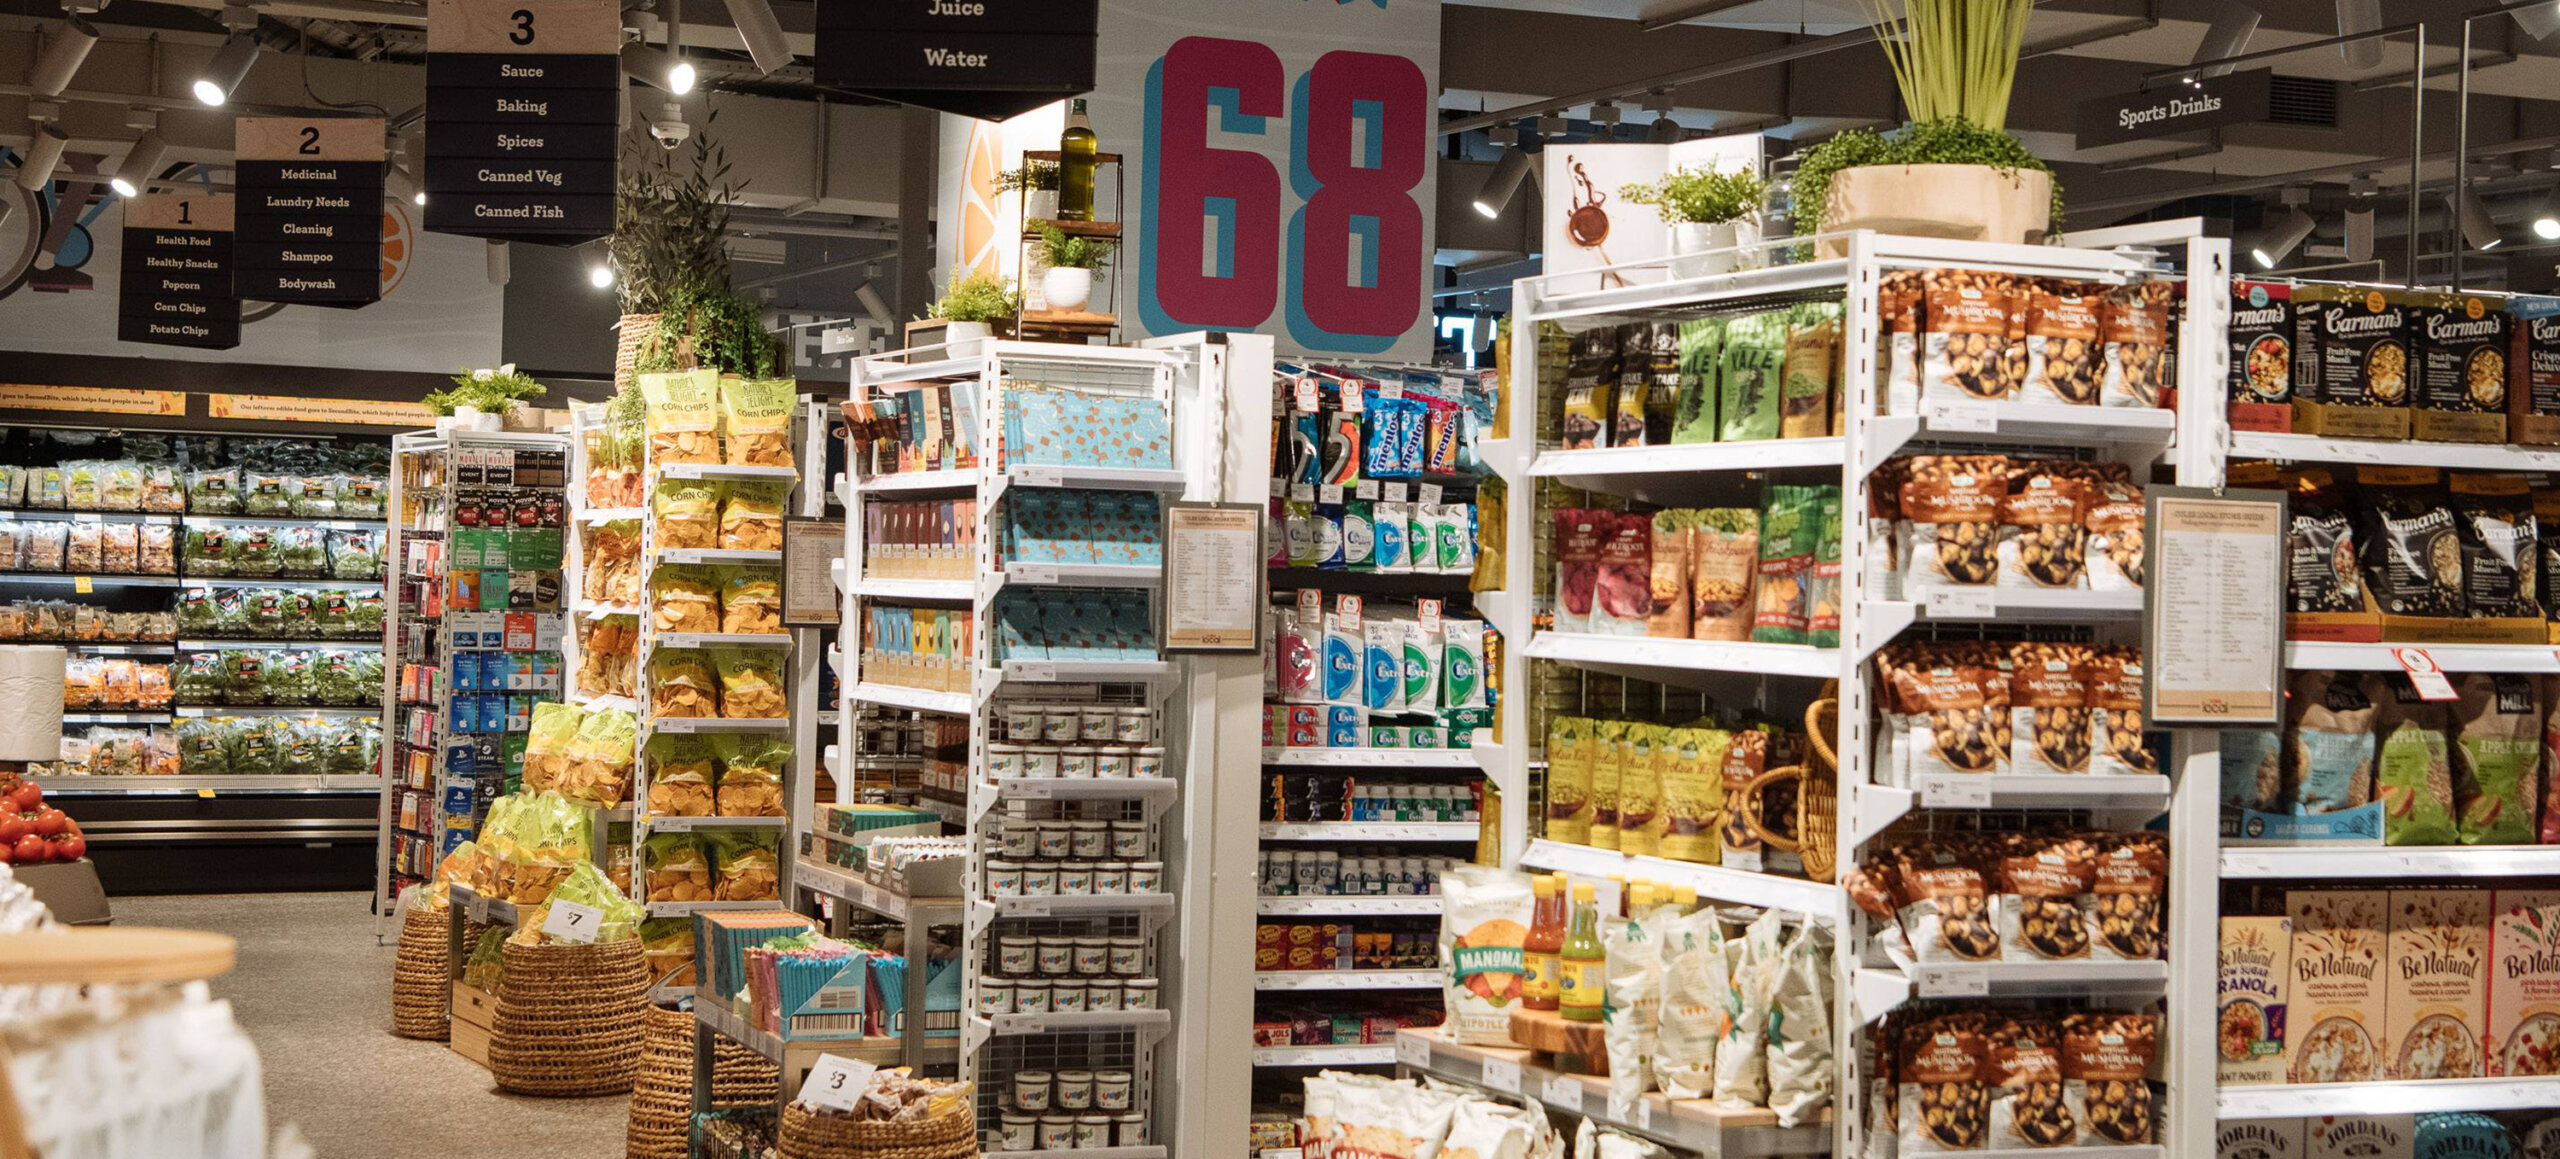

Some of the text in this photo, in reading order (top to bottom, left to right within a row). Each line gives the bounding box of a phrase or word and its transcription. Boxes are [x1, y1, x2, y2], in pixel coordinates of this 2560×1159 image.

[928, 0, 985, 16] Juice
[509, 9, 535, 45] 3
[924, 48, 988, 67] Water
[501, 64, 544, 77] Sauce
[496, 99, 548, 116] Baking
[2119, 94, 2222, 129] Sports Drinks
[299, 127, 320, 155] 2
[497, 135, 544, 151] Spices
[281, 168, 337, 181] Medicinal
[478, 169, 562, 186] Canned Veg
[267, 196, 350, 209] Laundry Needs
[1139, 36, 1427, 353] 68
[178, 201, 192, 225] 1
[474, 204, 564, 218] Canned Fish
[282, 223, 334, 236] Cleaning
[156, 235, 211, 247] Health Food
[146, 257, 218, 269] Healthy Snacks
[282, 251, 333, 263] Shampoo
[162, 279, 201, 291] Popcorn
[279, 278, 336, 290] Bodywash
[154, 302, 206, 314] Corn Chips
[2232, 303, 2285, 325] rman's
[150, 324, 209, 336] Potato Chips
[2325, 307, 2402, 334] Carman's
[2426, 313, 2500, 340] Carman's
[1682, 353, 1711, 374] ALE
[661, 402, 710, 413] CORN CHIPS
[736, 408, 786, 419] CORN CHIPS
[1324, 410, 1353, 485] 5
[1374, 409, 1399, 471] 3 mentos
[1401, 409, 1426, 471] 3 mentos
[1432, 409, 1457, 469] 3 mentos
[671, 491, 695, 502] CORN
[731, 490, 774, 504] CORN CHIPS
[2386, 507, 2449, 532] arman's
[669, 573, 692, 584] CORN
[2201, 702, 2229, 713] local
[2499, 693, 2532, 712] MILL
[567, 911, 584, 926] $7
[1459, 949, 1522, 971] MANOMA
[2231, 947, 2276, 969] Natural
[2294, 952, 2378, 982] Be Natural
[2398, 950, 2481, 979] Be Natural
[2503, 950, 2560, 979] Be Natu
[2217, 977, 2279, 1000] RANOLA
[1271, 1029, 1289, 1038] JOLS
[830, 1070, 847, 1089] $3
[2217, 1123, 2289, 1153] JORDANS
[2326, 1120, 2399, 1150] JORDANS
[2428, 1135, 2508, 1159] JORDAN
